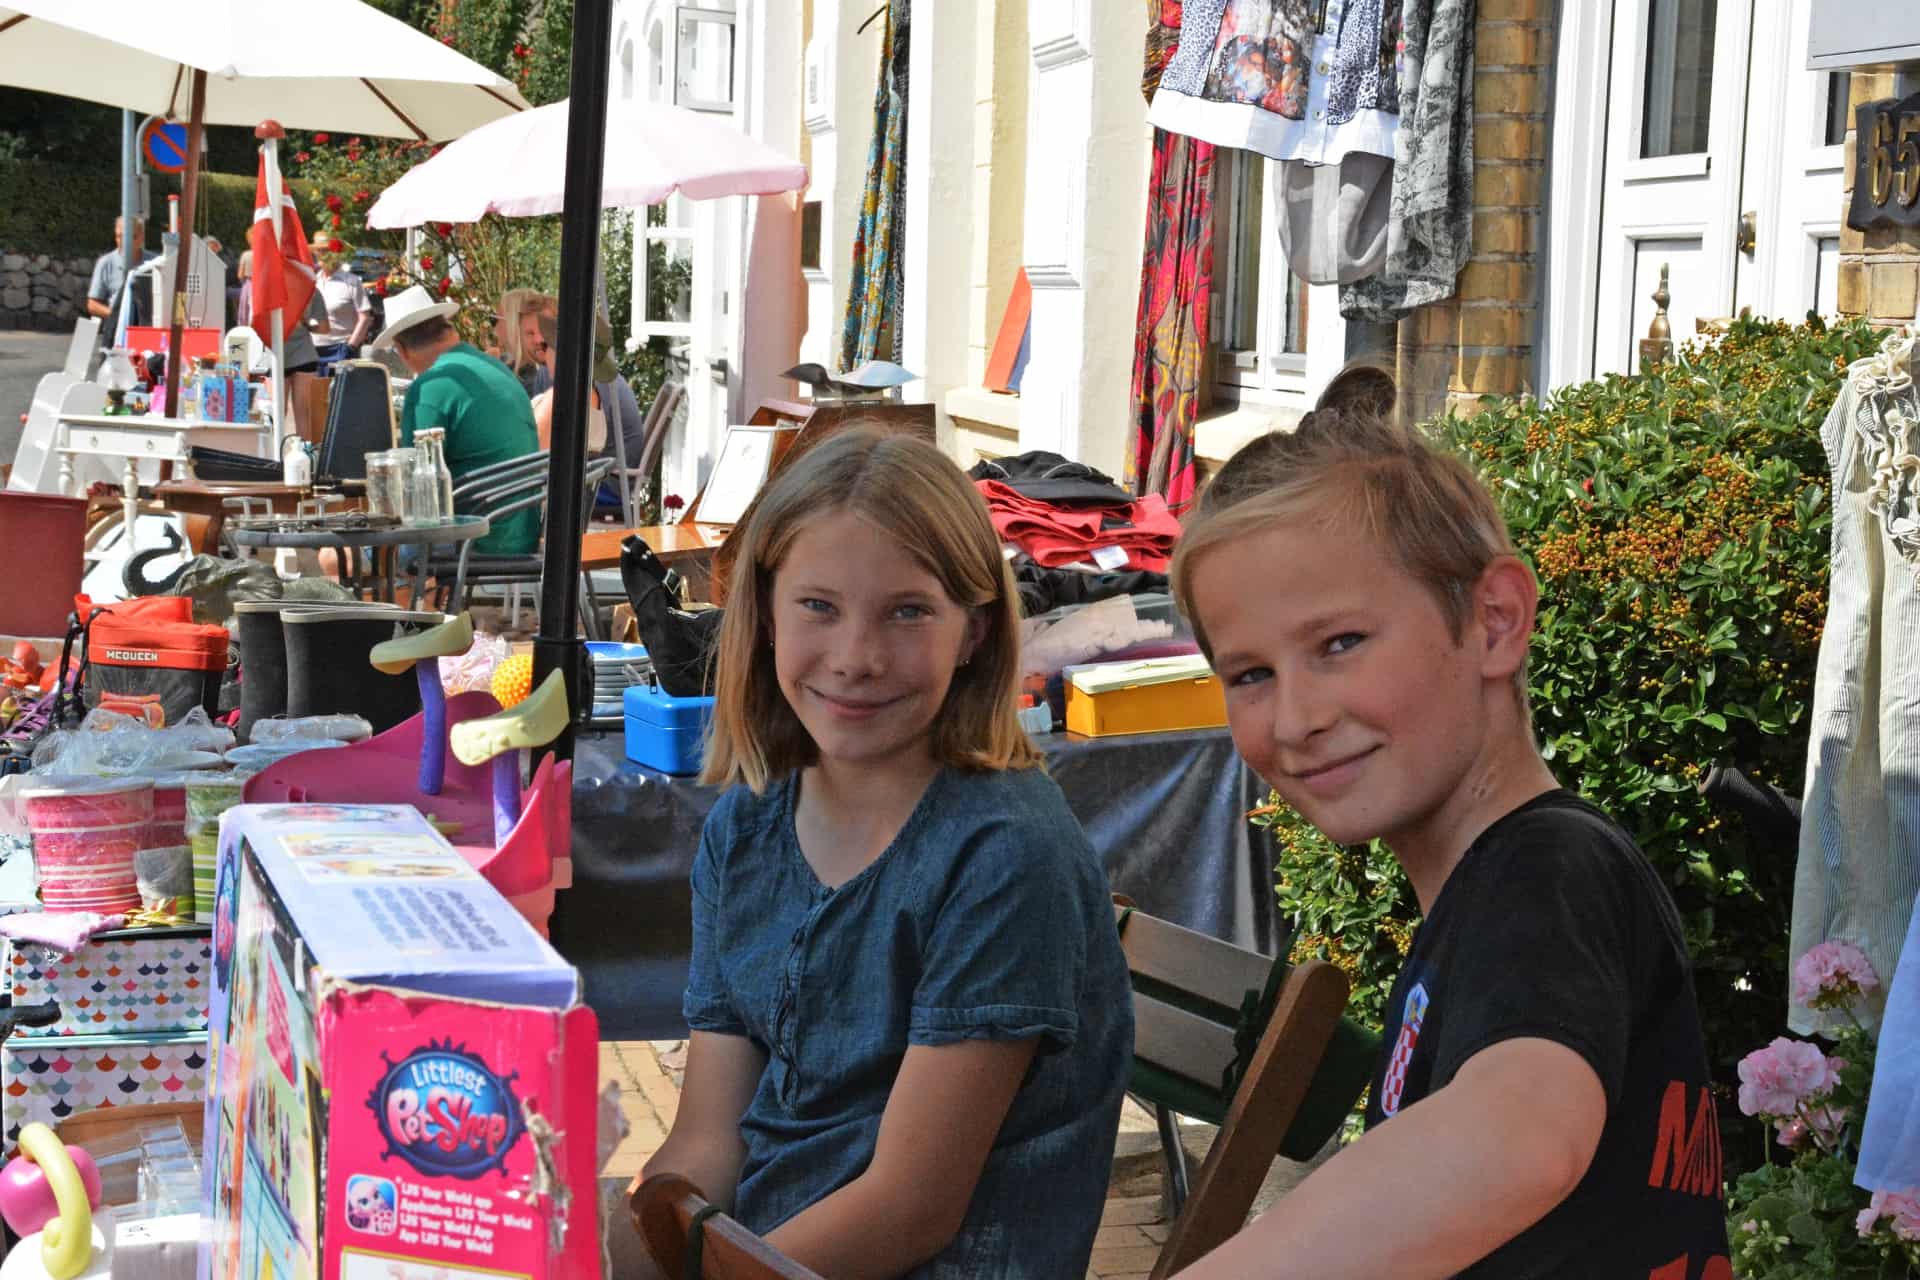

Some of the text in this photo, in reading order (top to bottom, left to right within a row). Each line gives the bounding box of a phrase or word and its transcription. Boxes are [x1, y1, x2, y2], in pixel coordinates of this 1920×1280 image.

[1870, 111, 1920, 208] 65
[106, 650, 158, 661] MCQUEEN
[410, 1061, 488, 1097] Littlest
[445, 1190, 472, 1205] World
[444, 1220, 471, 1235] World
[502, 1214, 533, 1231] World
[465, 1238, 494, 1254] World
